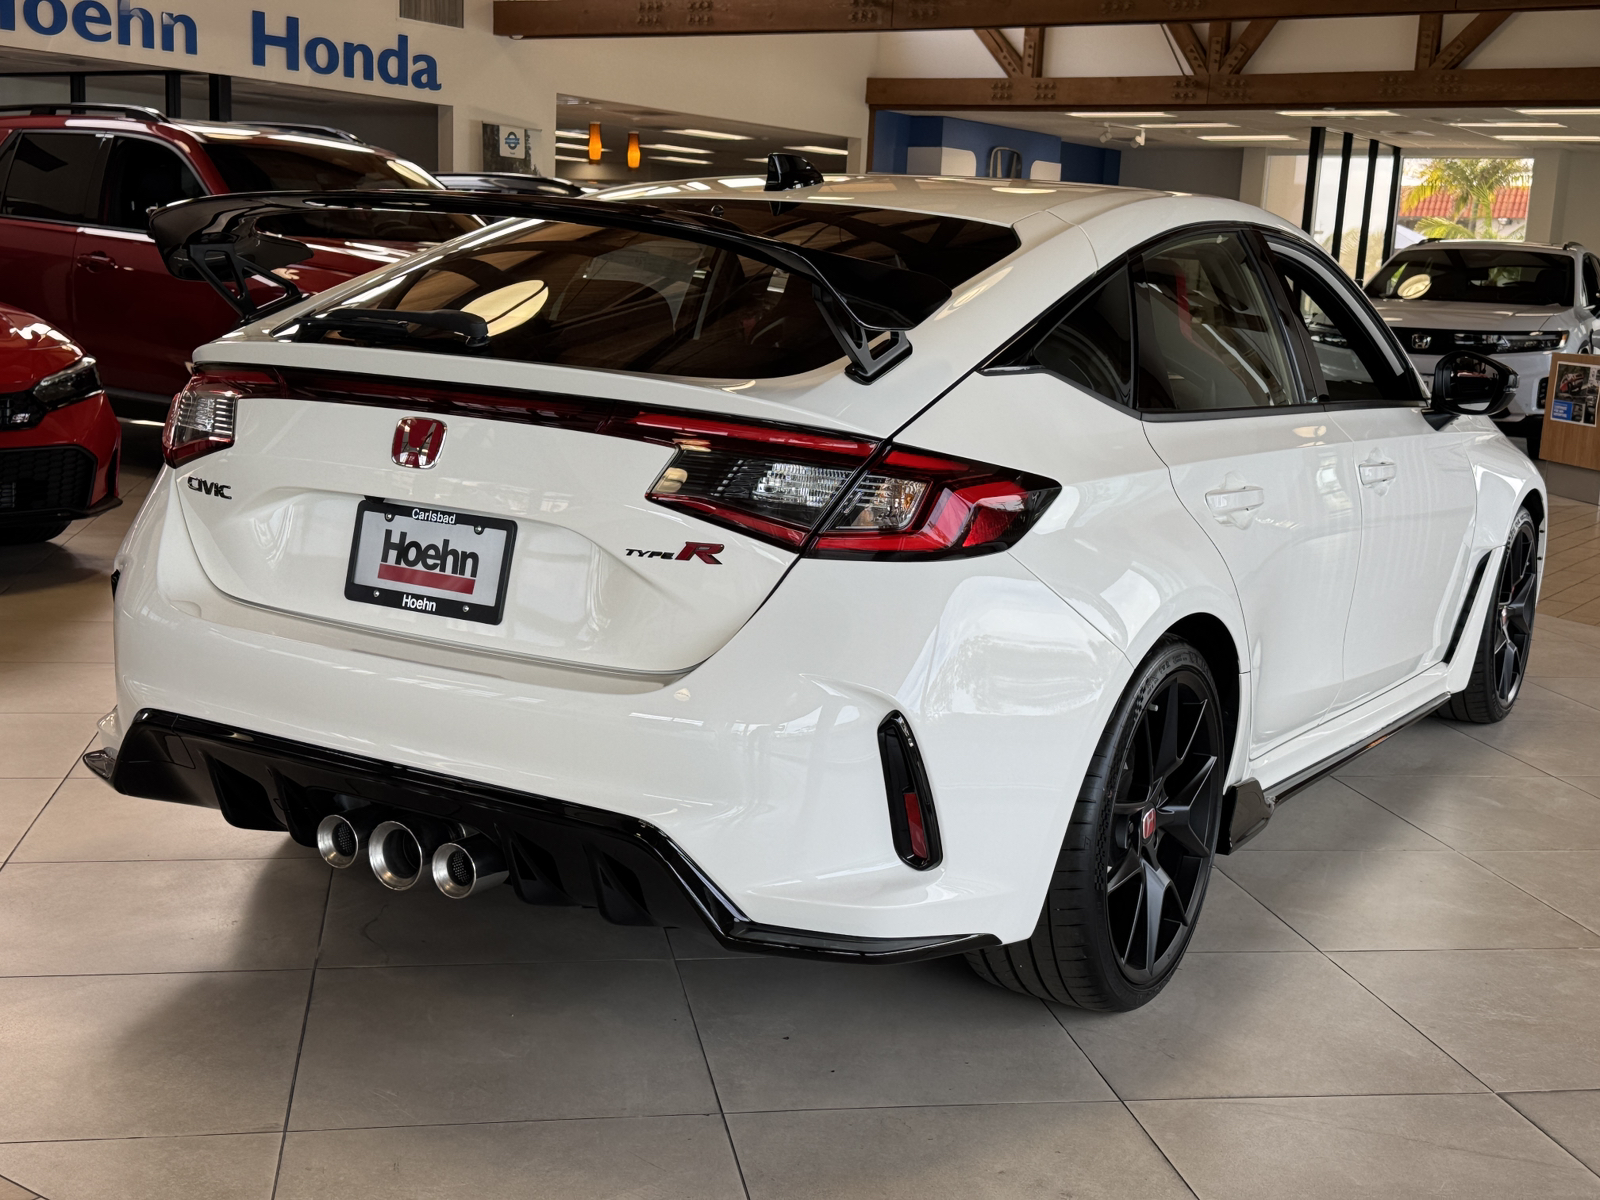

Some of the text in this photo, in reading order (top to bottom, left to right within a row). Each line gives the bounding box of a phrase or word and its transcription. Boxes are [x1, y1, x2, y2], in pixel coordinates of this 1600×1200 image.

[0, 0, 442, 91] oehn Honda
[187, 476, 232, 500] CIVIC
[411, 508, 456, 525] Carlsbad
[380, 528, 480, 579] Hoehn
[625, 541, 725, 565] TYPE R
[401, 594, 437, 612] Hoehn
